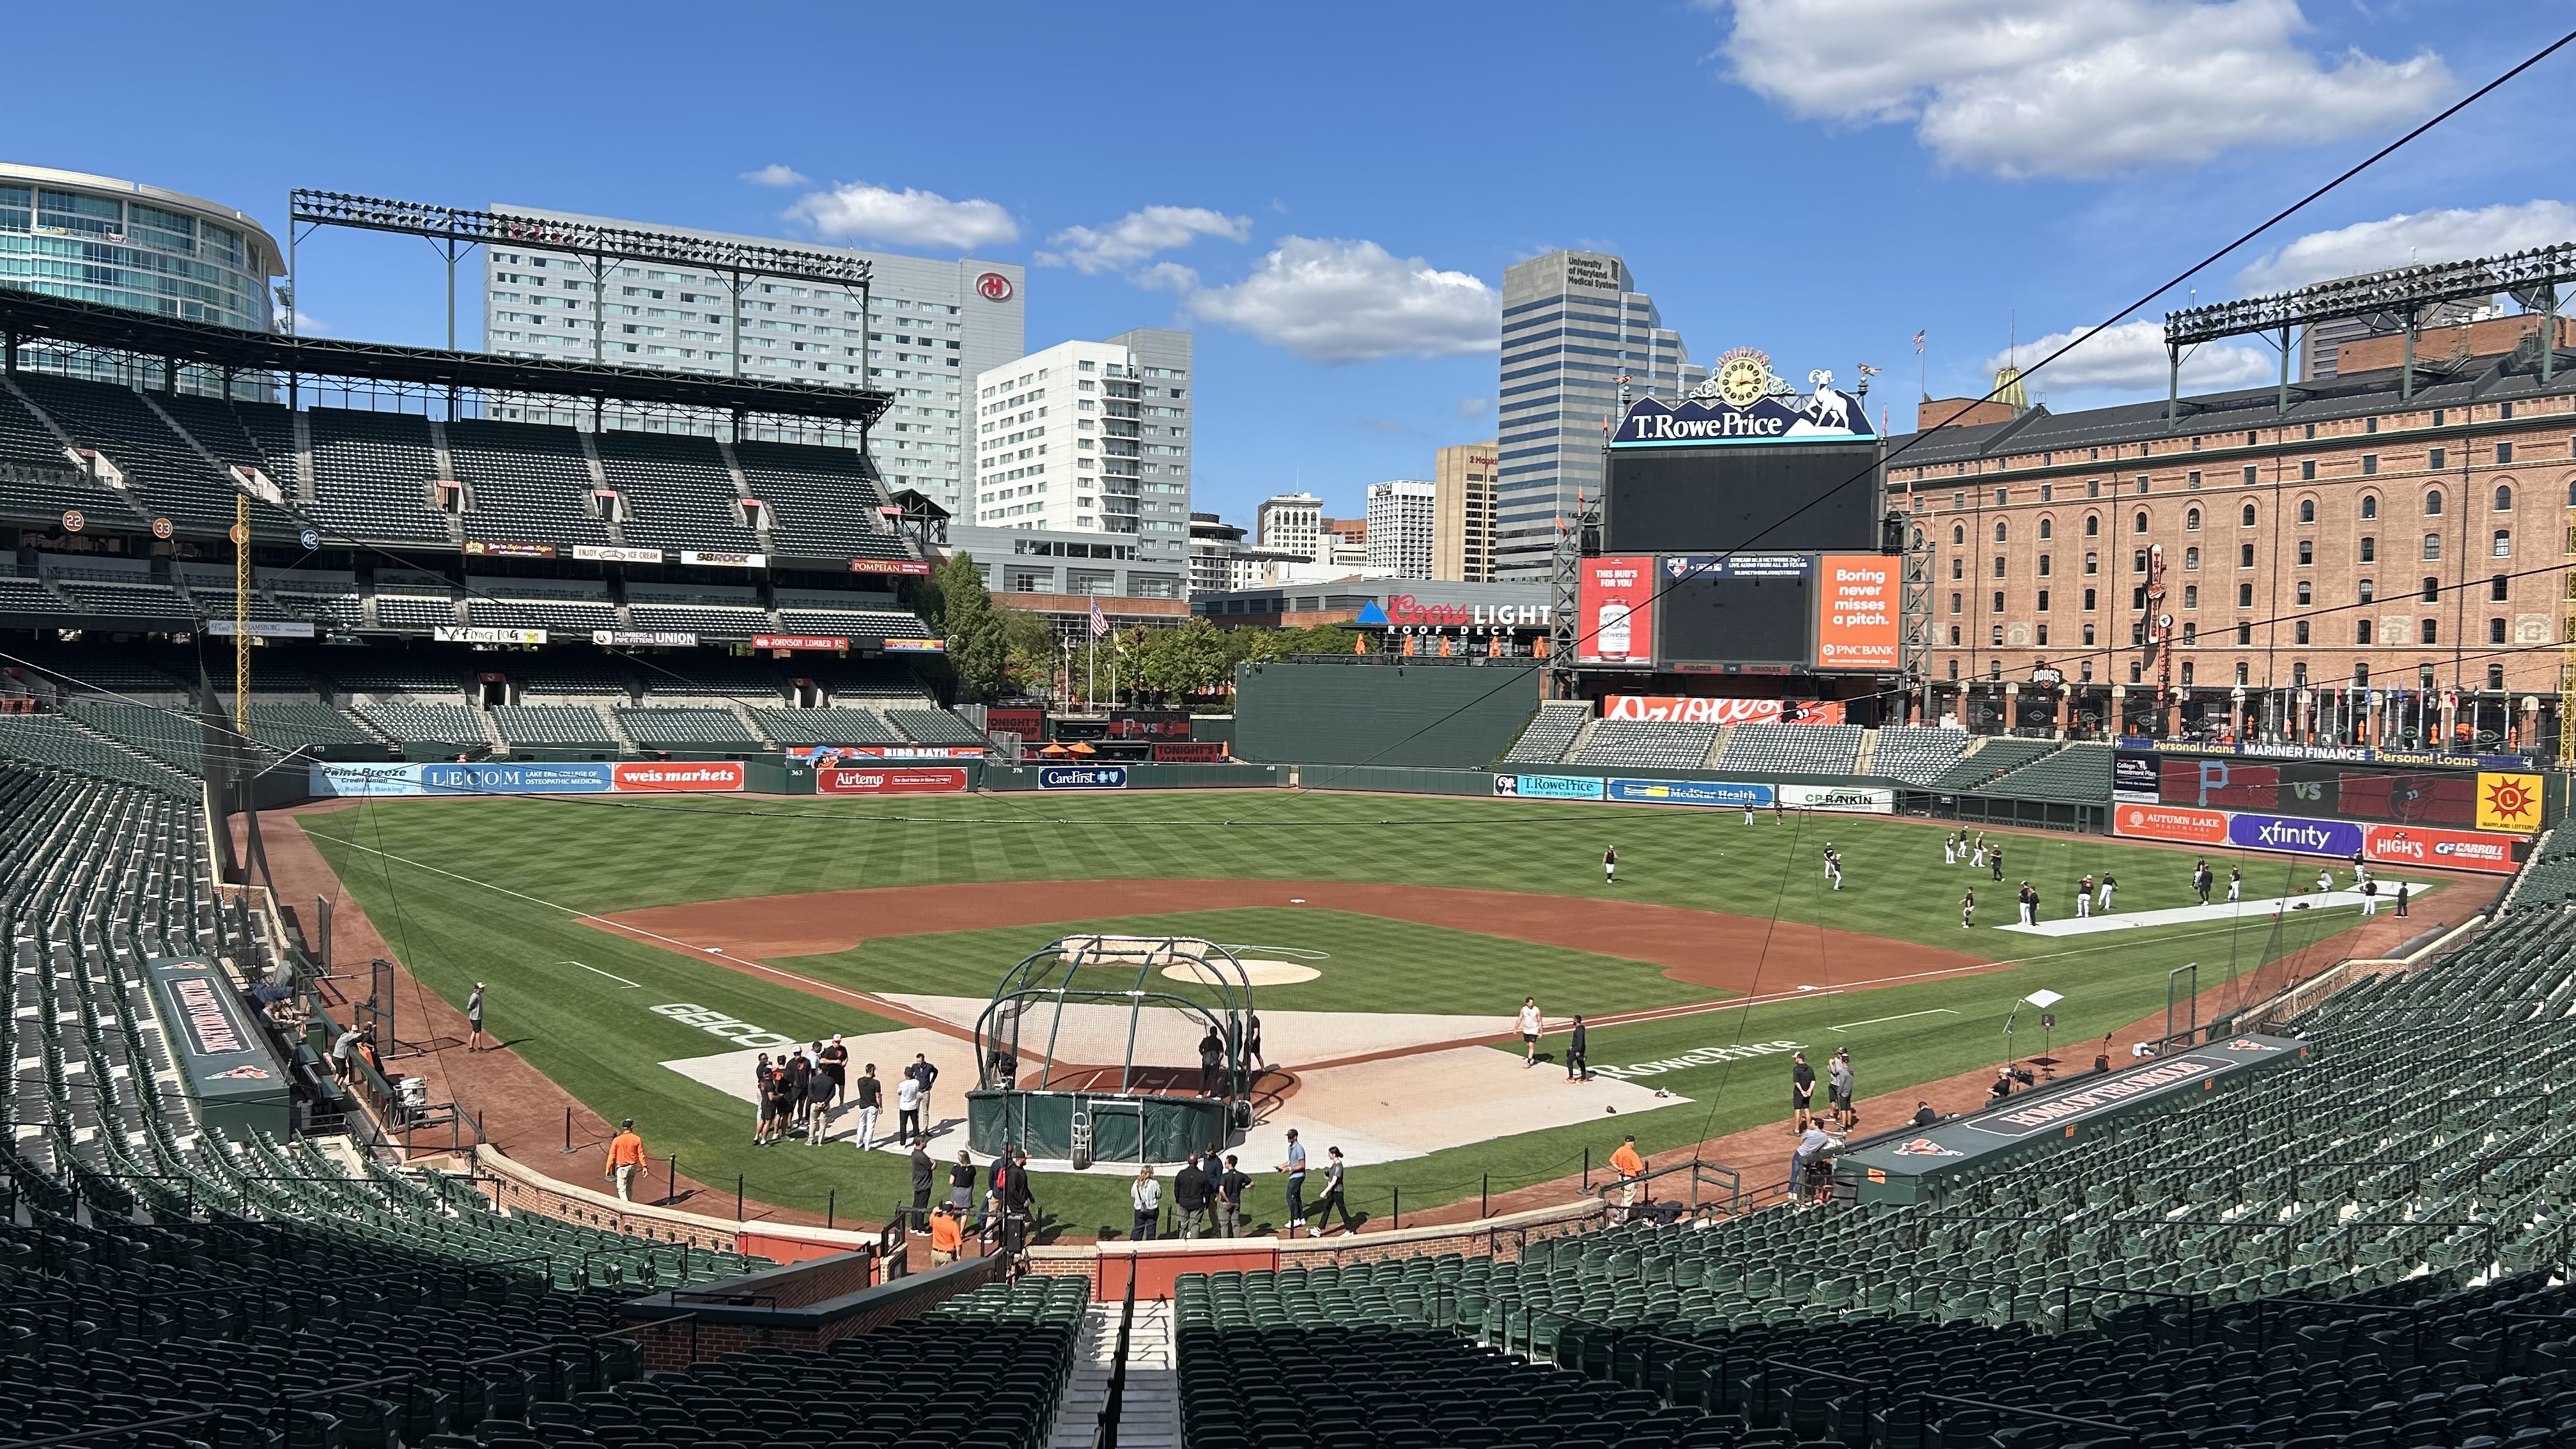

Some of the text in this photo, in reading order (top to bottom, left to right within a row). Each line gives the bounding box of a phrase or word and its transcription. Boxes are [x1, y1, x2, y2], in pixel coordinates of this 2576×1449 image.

[1569, 256, 1602, 270] University
[1569, 267, 1607, 279] of Maryland
[1568, 275, 1618, 290] Medical System
[1470, 455, 1475, 463] 2
[66, 516, 81, 527] 22
[157, 523, 171, 533] 33
[303, 534, 316, 544] 42
[854, 562, 900, 572] POMPEIAN
[1595, 570, 1638, 578] THIS BUD'S
[1836, 568, 1885, 584] Boring
[1839, 585, 1882, 596] never
[1390, 594, 1551, 624] Coors LIGHT
[1835, 598, 1886, 610] misses
[1833, 612, 1889, 627] a pitch.
[212, 623, 230, 632] Visit
[1388, 625, 1515, 635] ROOF DECK
[497, 630, 519, 640] DOG
[656, 632, 695, 644] UNION
[771, 639, 803, 647] JOHNSON
[805, 639, 832, 647] LUMBER
[2033, 669, 2060, 683] BOOG'S
[884, 748, 913, 757] BIRD
[917, 748, 949, 757] BATH
[1158, 746, 1213, 754] TONIGHT'S
[2153, 742, 2478, 767] Personal Loans MARINER FINANCE Personal Loans
[362, 768, 407, 777] Breeze
[623, 768, 734, 782] weis markets
[836, 772, 883, 785] Airtemp
[1048, 771, 1096, 784] CareFirst
[2199, 760, 2229, 807] P
[1670, 788, 1756, 800] MedStar Health
[2146, 814, 2219, 827] AUTUMN LAKE
[2156, 824, 2209, 833] HEALTHCARE
[2258, 821, 2331, 849] xfinity
[2377, 838, 2424, 858] HIGH'S
[2455, 842, 2504, 856] CARROLL
[649, 1003, 798, 1048] GEICO
[1996, 1060, 2214, 1129] HOME OF THE ORIOLES
